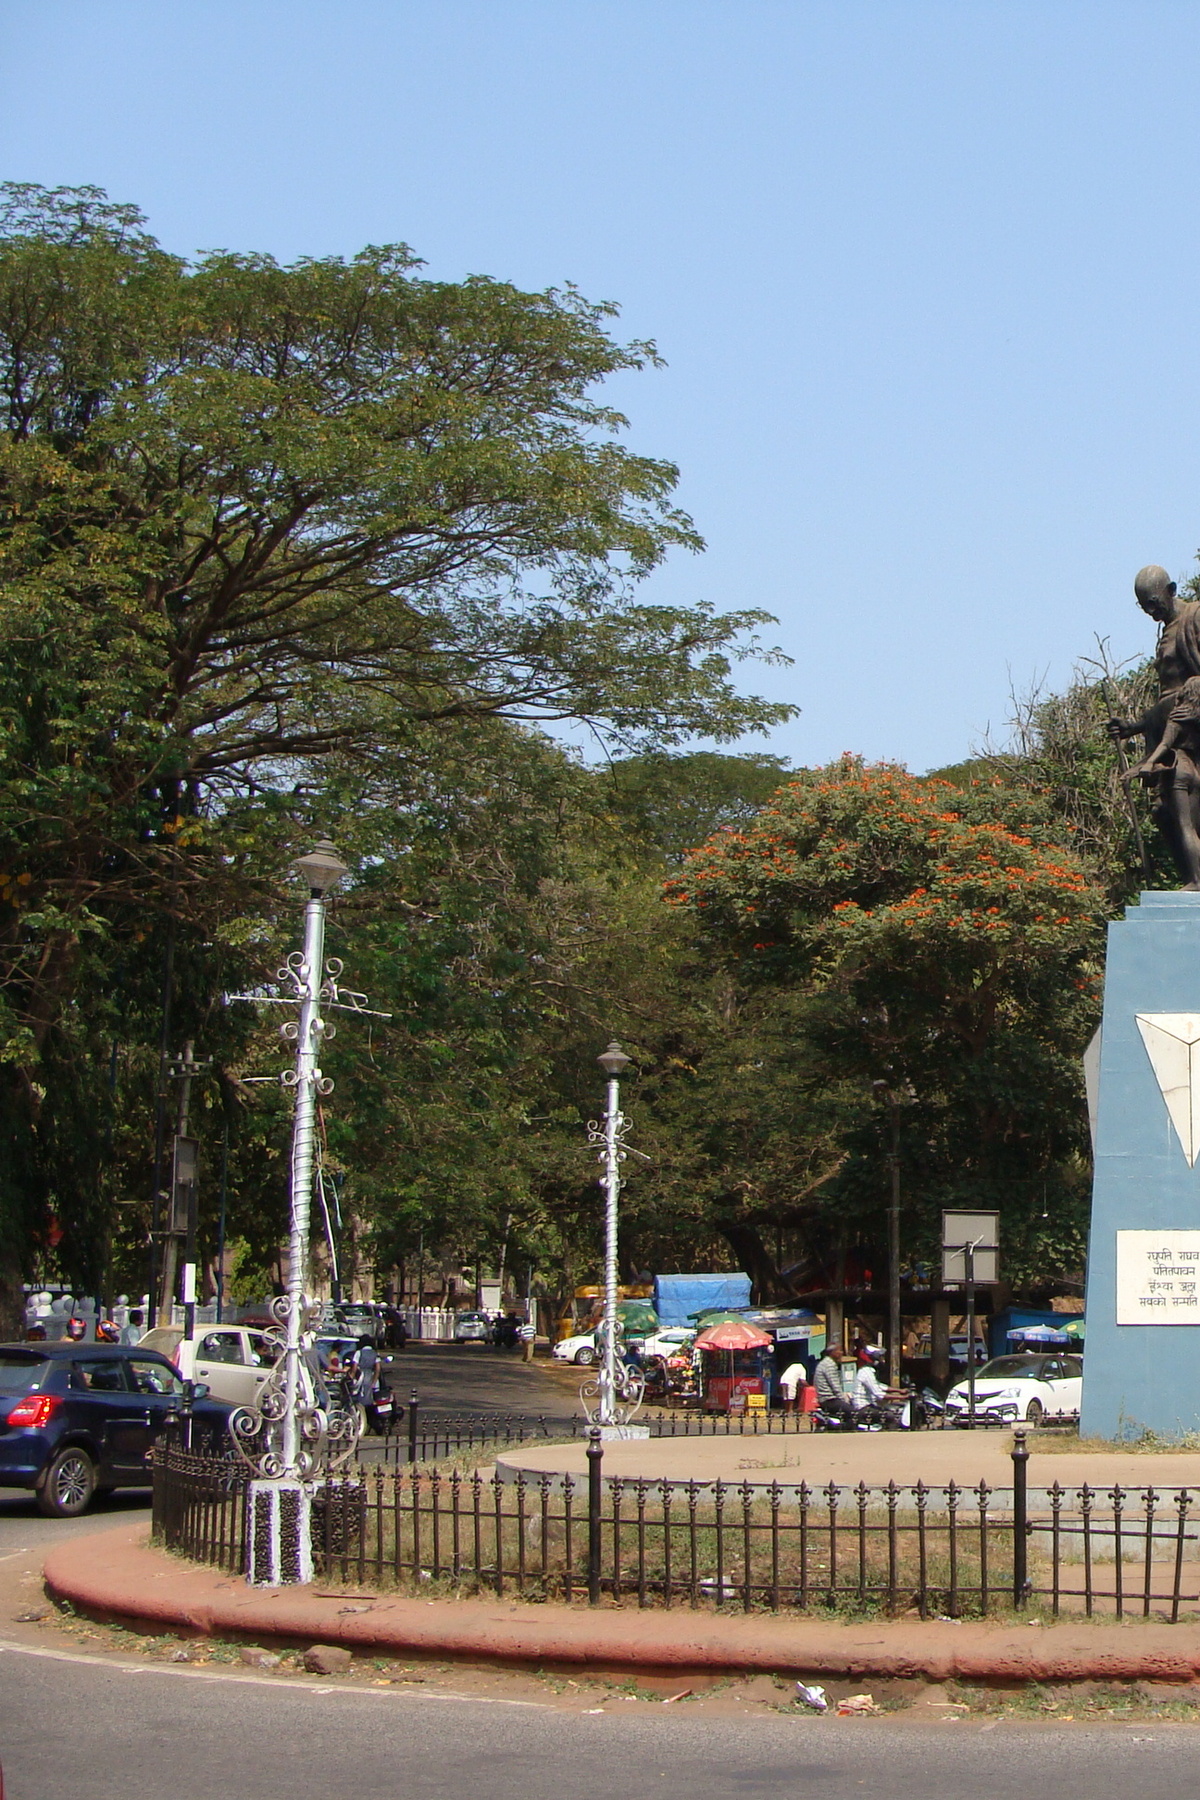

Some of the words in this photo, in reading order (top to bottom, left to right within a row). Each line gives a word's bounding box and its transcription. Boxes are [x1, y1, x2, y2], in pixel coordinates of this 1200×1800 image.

[1146, 1248, 1172, 1264] रघुपति
[1177, 1251, 1200, 1261] राघव
[1152, 1262, 1196, 1276] पतितपावन
[1171, 1293, 1198, 1307] सन्मति
